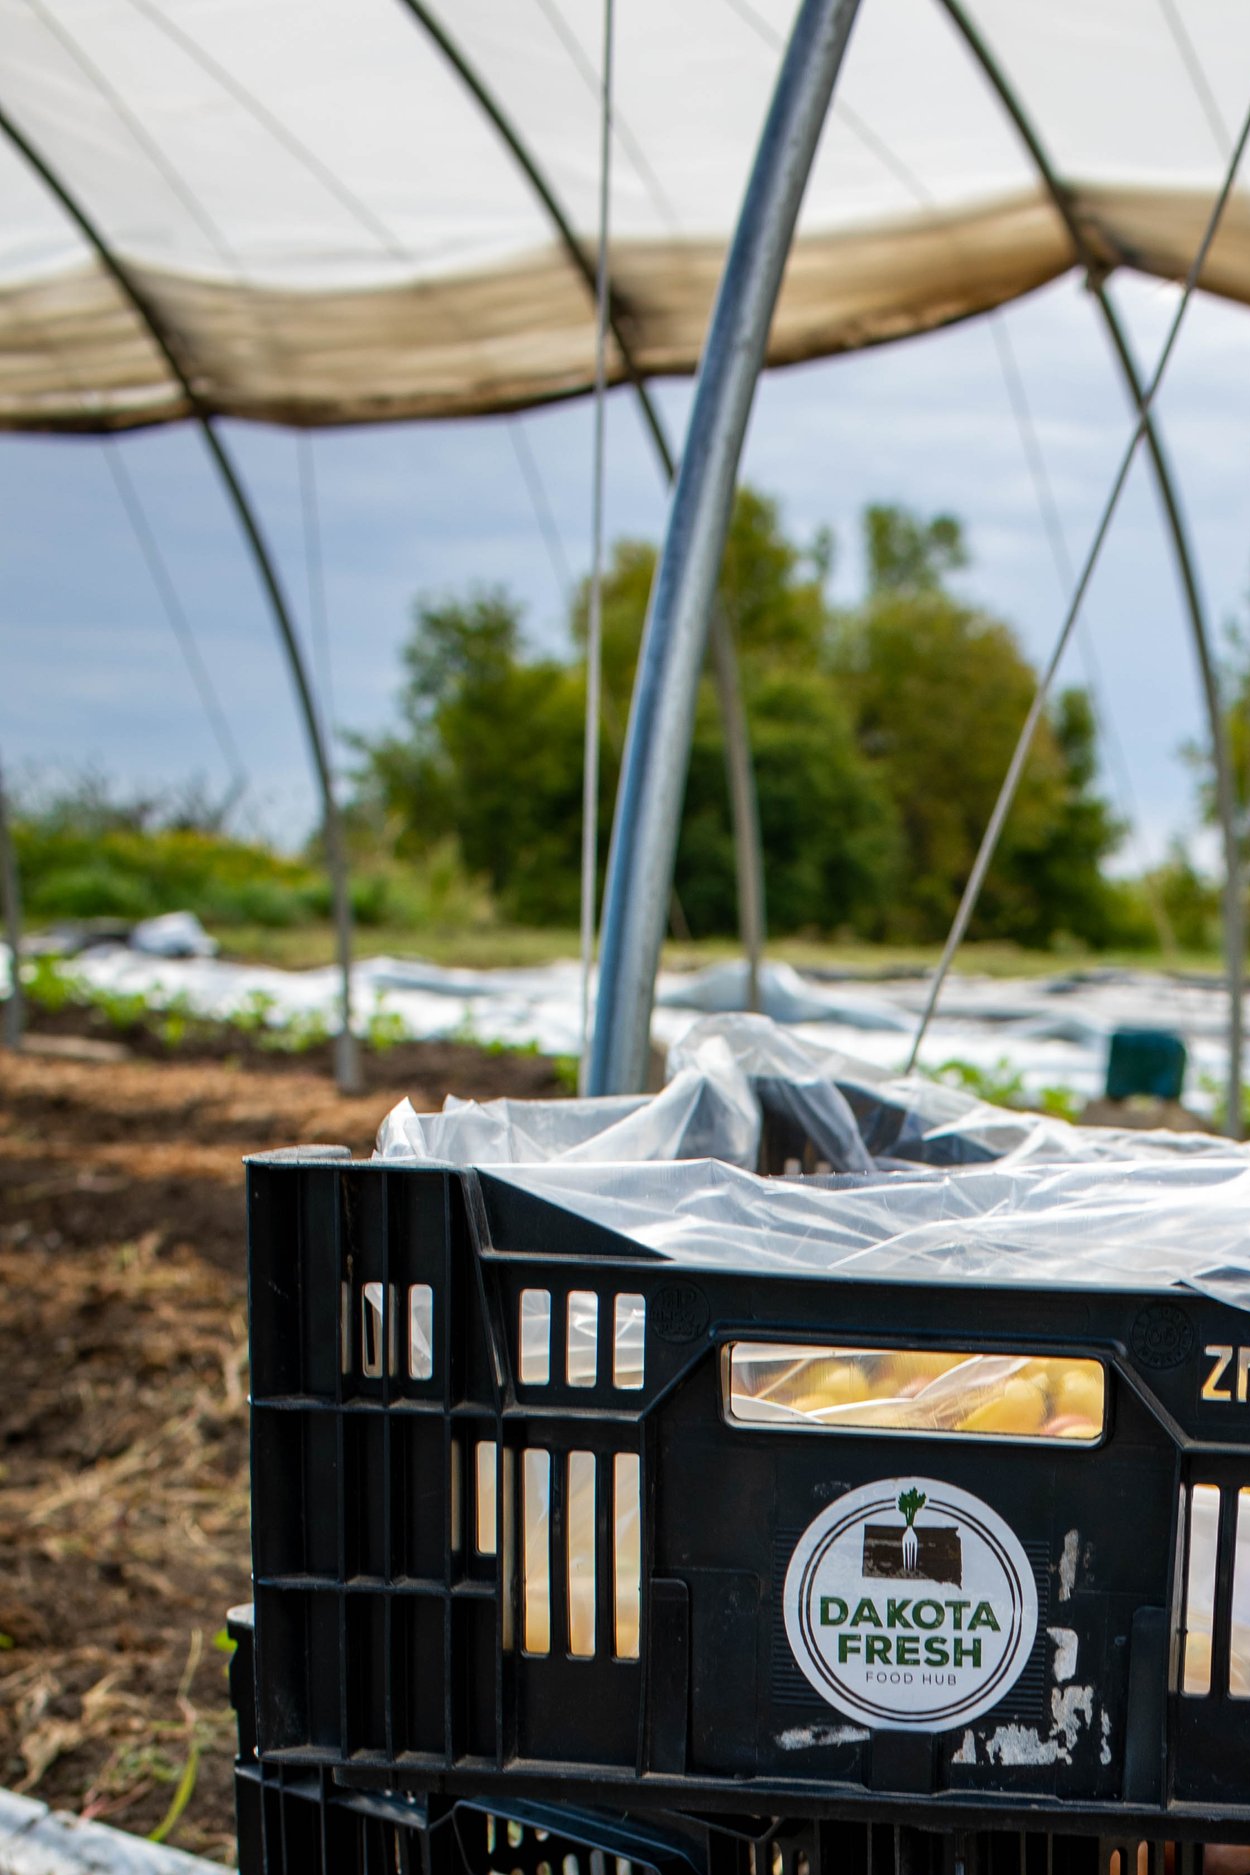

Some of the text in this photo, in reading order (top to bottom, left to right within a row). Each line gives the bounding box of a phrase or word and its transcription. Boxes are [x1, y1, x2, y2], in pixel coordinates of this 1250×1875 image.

[820, 1596, 1001, 1632] DAKOTA
[838, 1634, 982, 1668] FRESH
[865, 1672, 957, 1686] FOOD HUB
